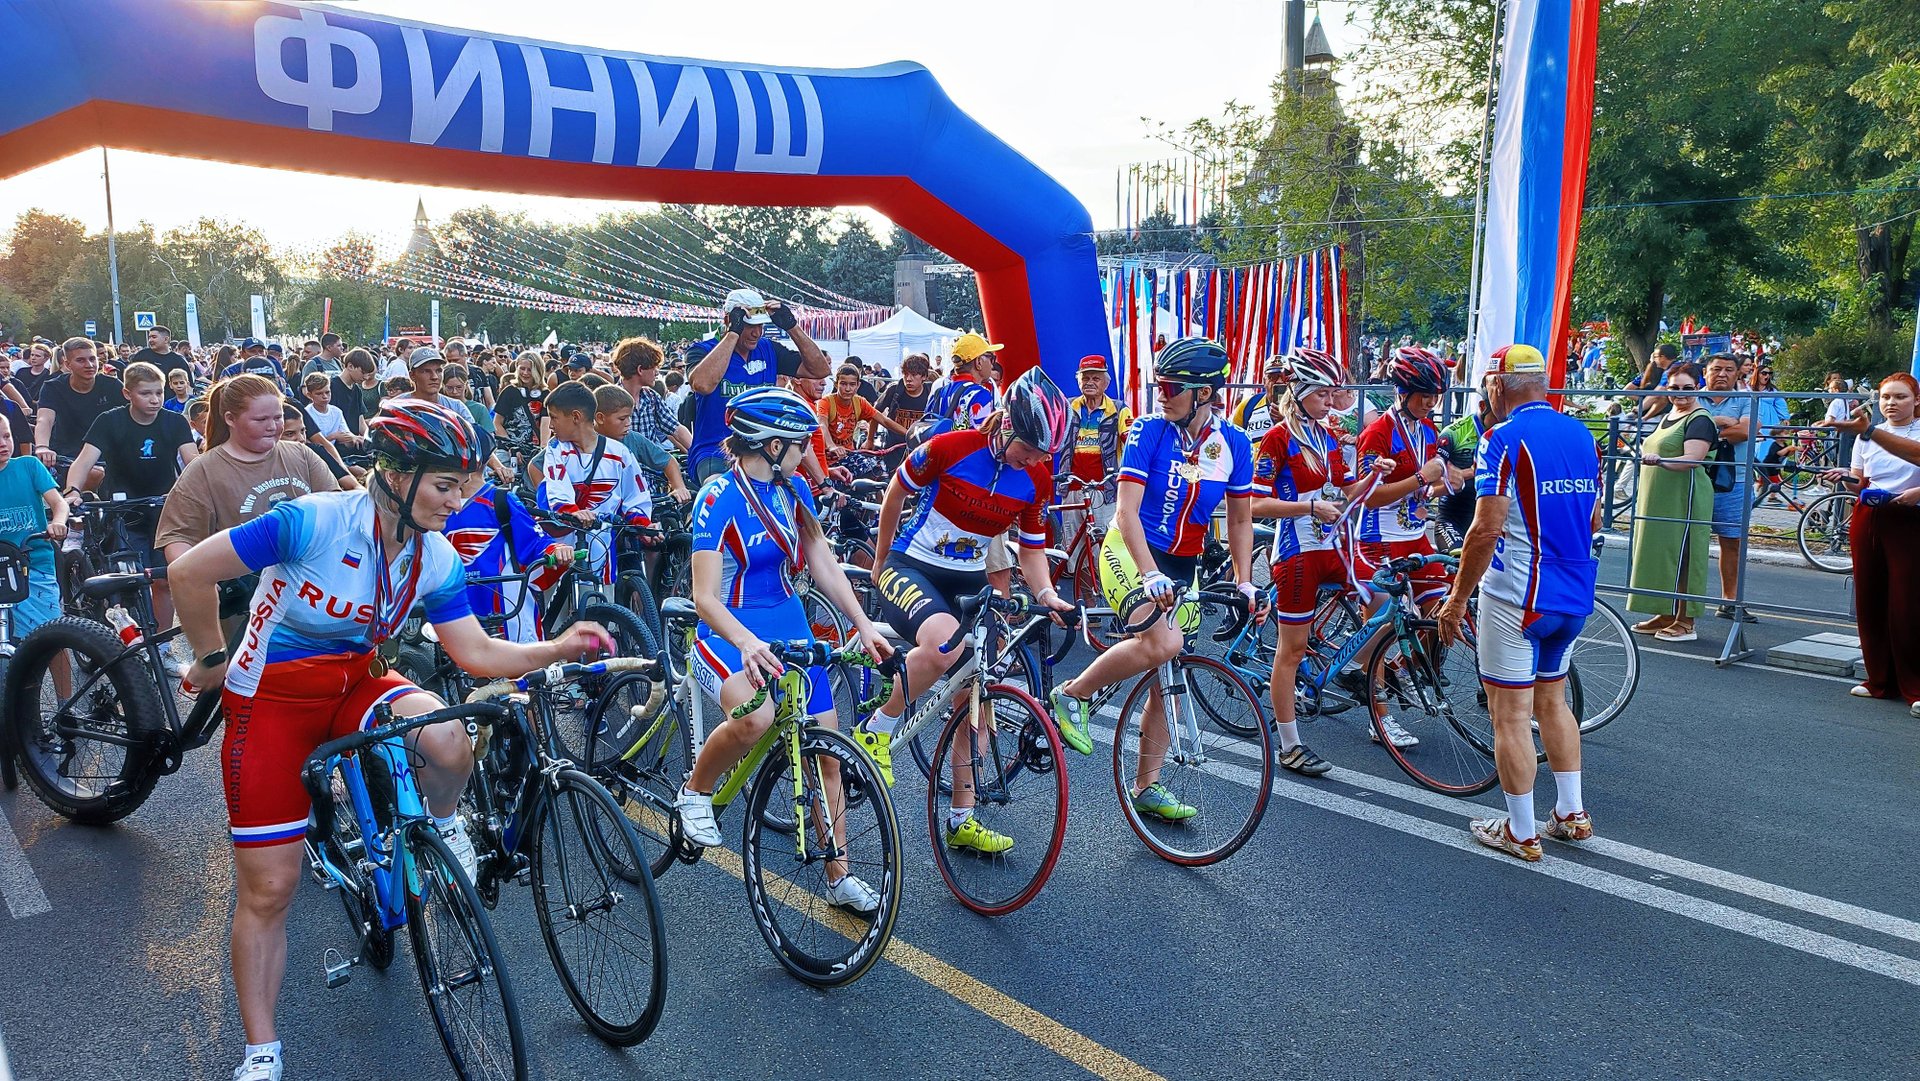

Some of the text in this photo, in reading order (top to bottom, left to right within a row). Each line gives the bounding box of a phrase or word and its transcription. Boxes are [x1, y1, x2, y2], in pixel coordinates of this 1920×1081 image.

[254, 10, 824, 176] ФИНИШ
[773, 418, 809, 431] LIMAR
[547, 464, 567, 481] 17
[1540, 478, 1596, 495] RUSSIA
[239, 492, 257, 515] More
[1155, 459, 1183, 536] RUSSIA
[237, 577, 287, 671] RUSSIA
[297, 580, 375, 625] RUS
[687, 688, 697, 765] annondale
[230, 697, 254, 813] траханская
[250, 1055, 275, 1066] SIDI
